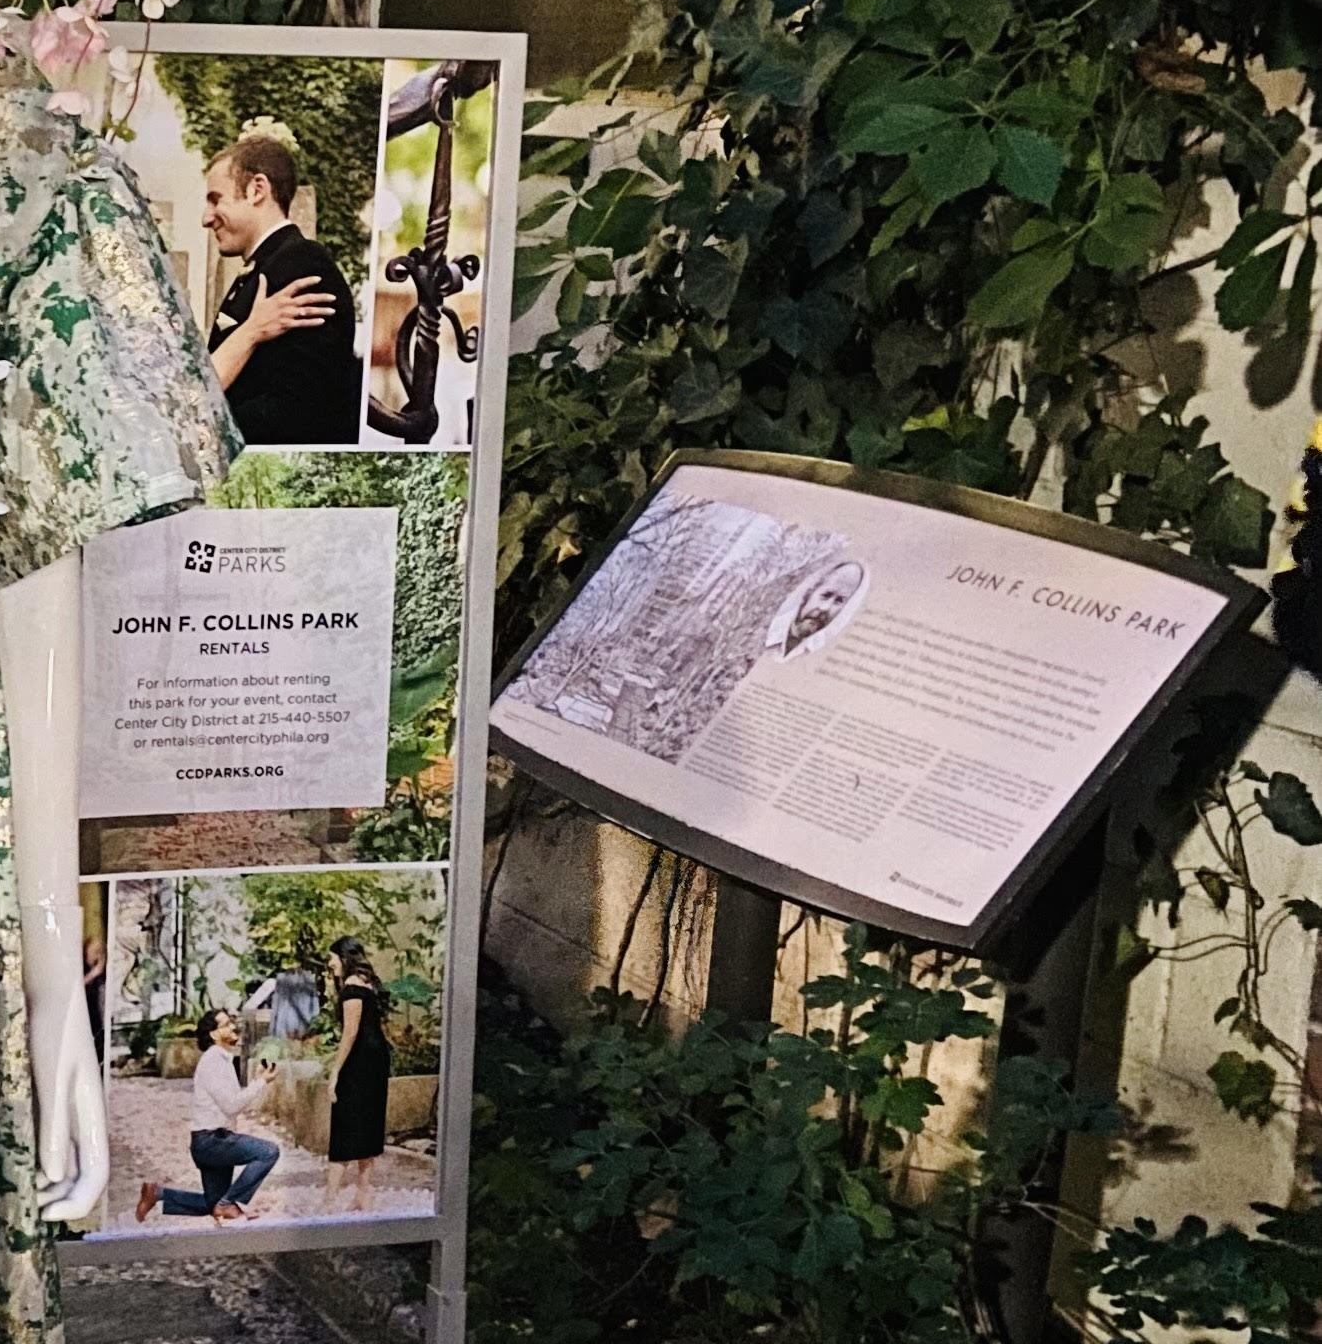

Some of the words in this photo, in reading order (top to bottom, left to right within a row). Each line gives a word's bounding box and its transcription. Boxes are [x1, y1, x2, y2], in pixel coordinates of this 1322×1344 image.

[218, 555, 287, 574] PARKS
[946, 564, 1005, 591] JOHN
[1007, 580, 1024, 598] F.
[1032, 587, 1122, 623] COLLINS
[1125, 611, 1186, 640] PARK
[112, 616, 171, 634] JOHN
[179, 616, 196, 632] F.
[203, 613, 294, 631] COLLINS
[301, 612, 360, 630] PARK
[199, 641, 270, 656] RENTALS
[137, 678, 159, 690] For
[163, 675, 238, 688] information
[241, 675, 279, 687] about
[284, 674, 331, 687] renting
[129, 698, 153, 710] this
[155, 696, 184, 711] park
[188, 695, 206, 707] for
[211, 696, 240, 709] your
[287, 693, 337, 705] contact
[114, 717, 157, 730] Center
[162, 715, 188, 730] City
[192, 714, 238, 727] District
[242, 713, 256, 725] at
[258, 710, 351, 725] 215-440-5507
[133, 739, 148, 749] or
[176, 765, 285, 780] CCDPARKS.ORG
